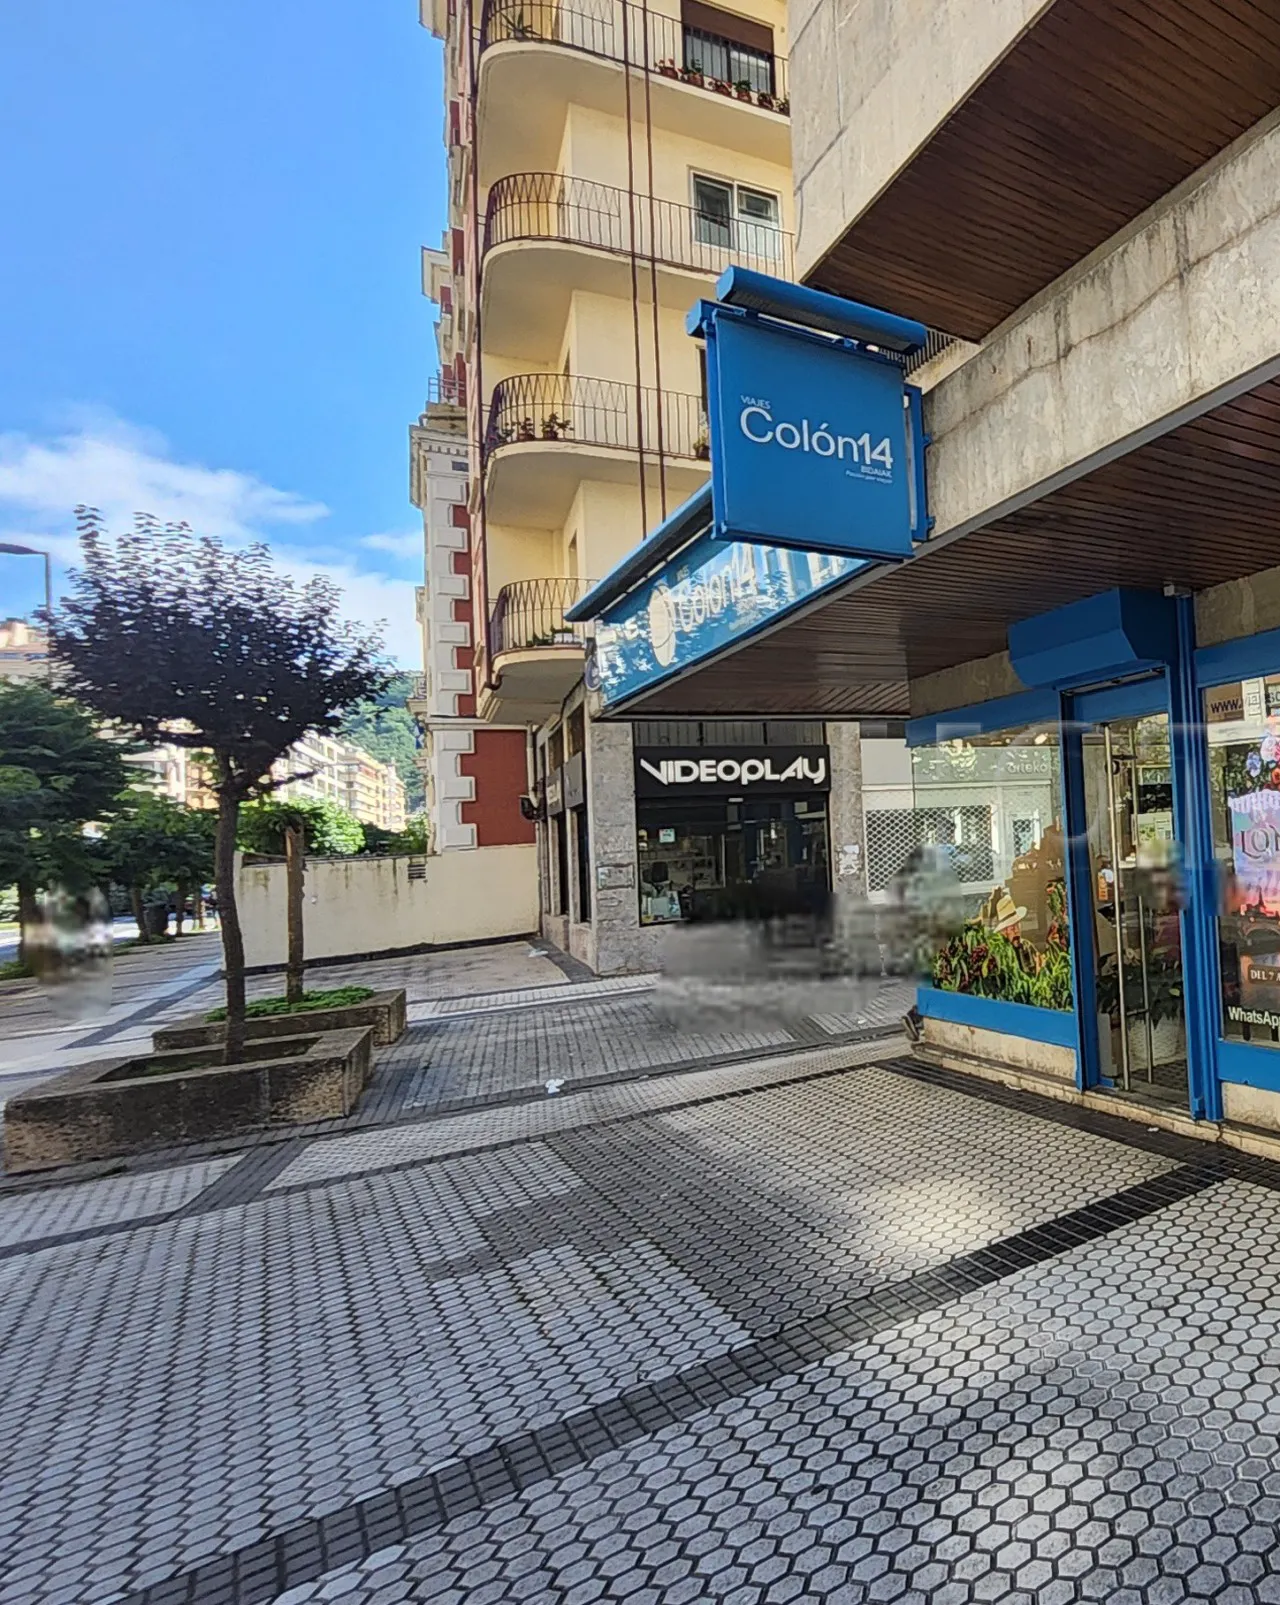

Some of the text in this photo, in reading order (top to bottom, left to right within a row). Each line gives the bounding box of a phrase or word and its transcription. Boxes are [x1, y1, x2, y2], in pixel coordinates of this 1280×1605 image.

[740, 394, 771, 410] VIAJES
[740, 406, 894, 470] Colón14
[640, 756, 826, 786] VIDEOPLAY
[1250, 969, 1268, 981] DEL
[1268, 971, 1275, 981] 7
